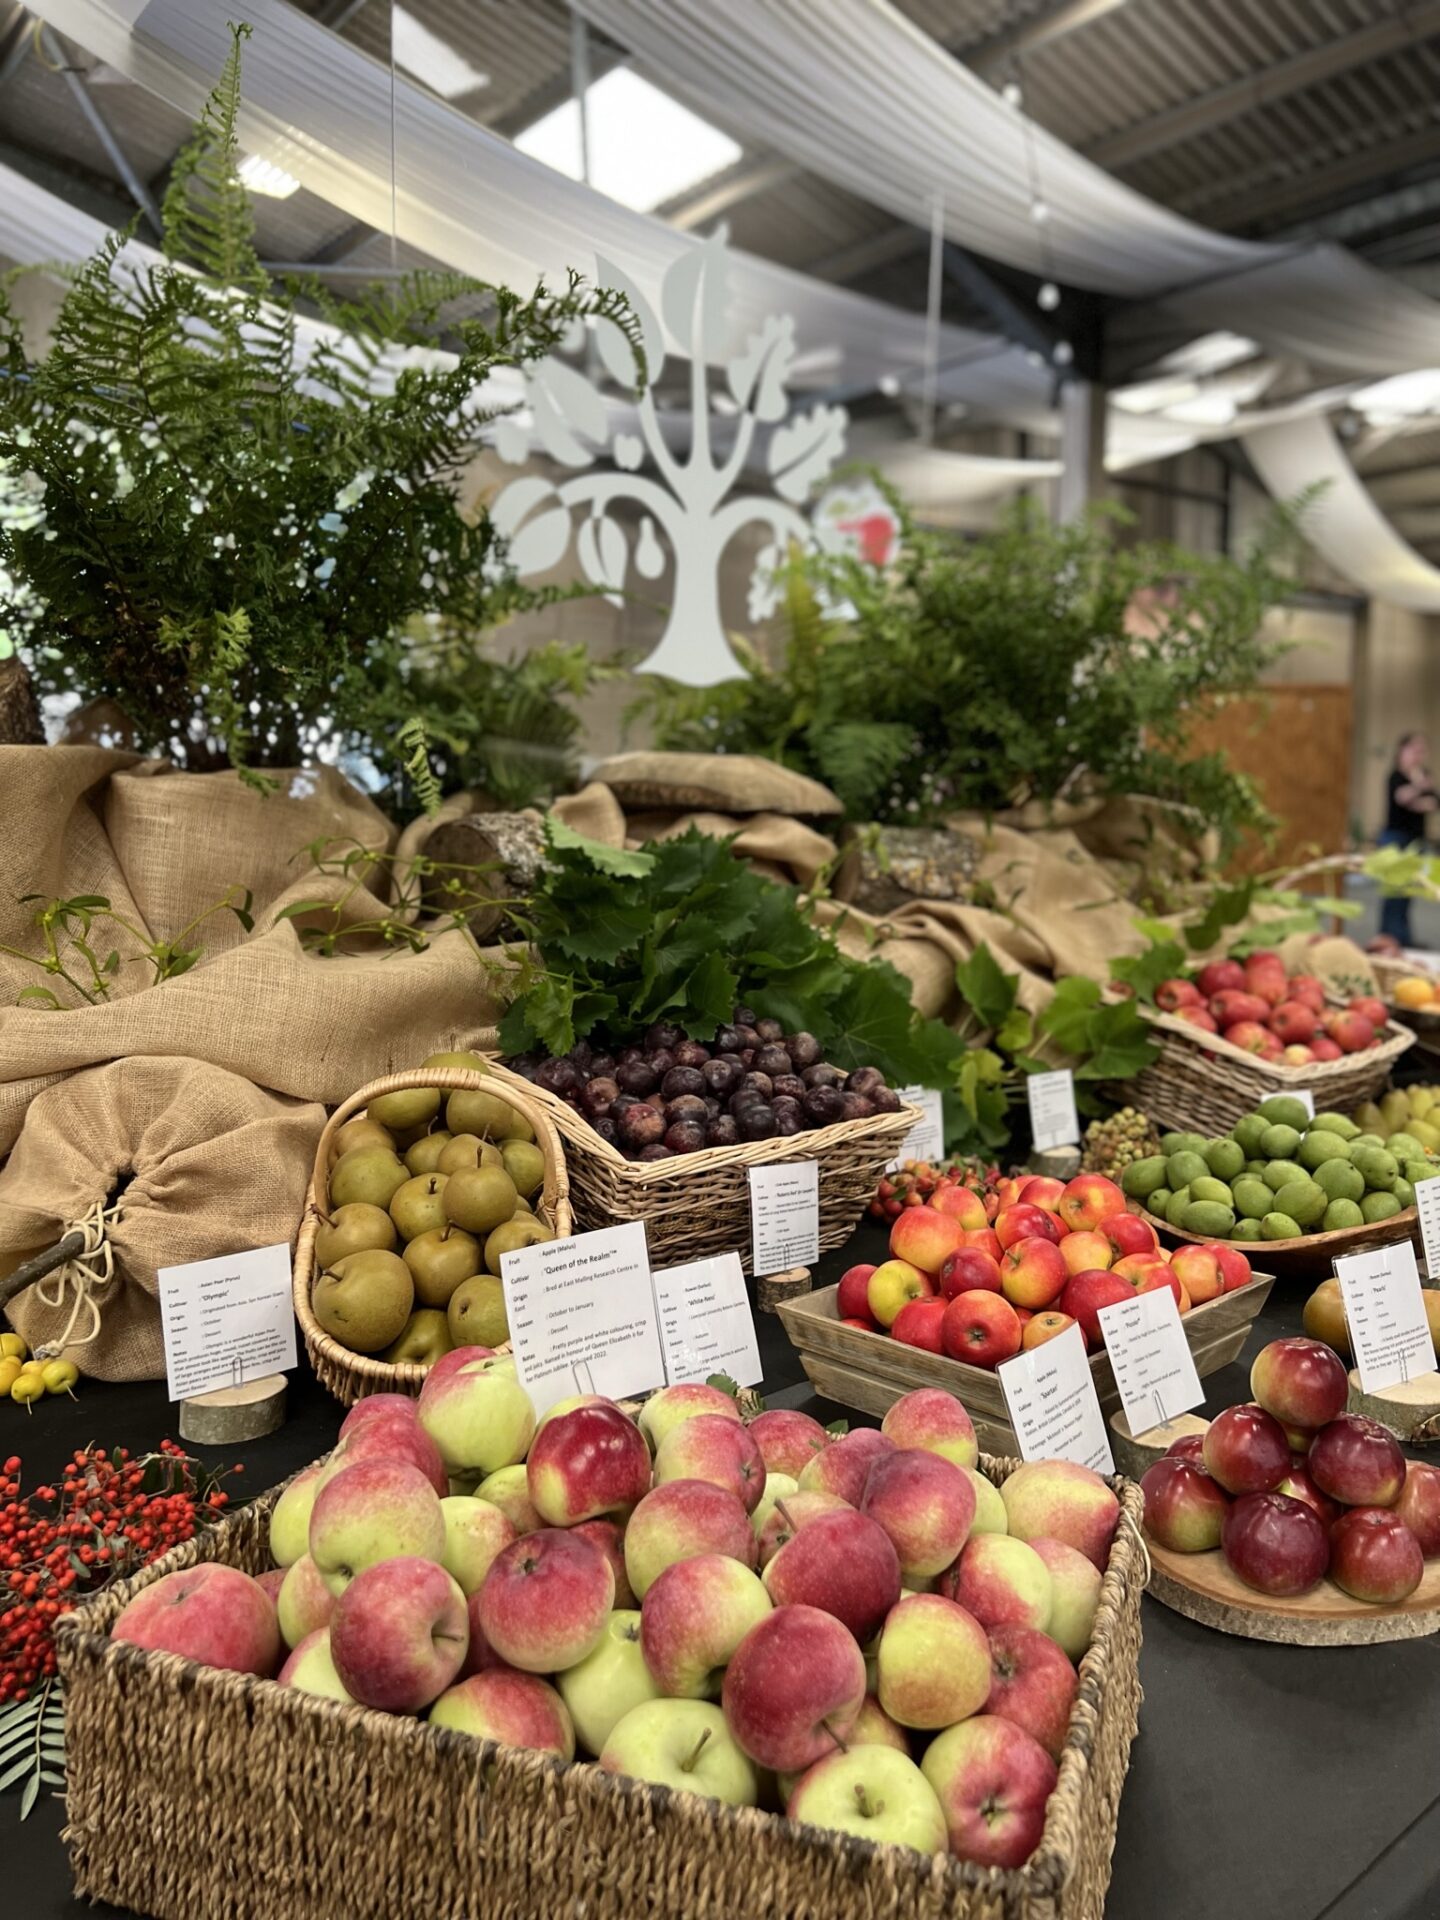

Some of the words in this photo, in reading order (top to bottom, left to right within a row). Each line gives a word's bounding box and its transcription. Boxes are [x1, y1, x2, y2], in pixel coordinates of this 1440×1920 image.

[557, 1243, 576, 1253] (Malus)
[510, 1275, 529, 1284] Cultivar
[513, 1294, 528, 1302] Origin
[593, 1269, 616, 1278] Research
[548, 1308, 567, 1318] October
[575, 1302, 594, 1310] January
[550, 1324, 568, 1334] Dessert
[552, 1342, 566, 1350] Pretty
[567, 1337, 583, 1347] purple
[591, 1341, 608, 1349] Queen
[609, 1333, 631, 1344] Elizabeth
